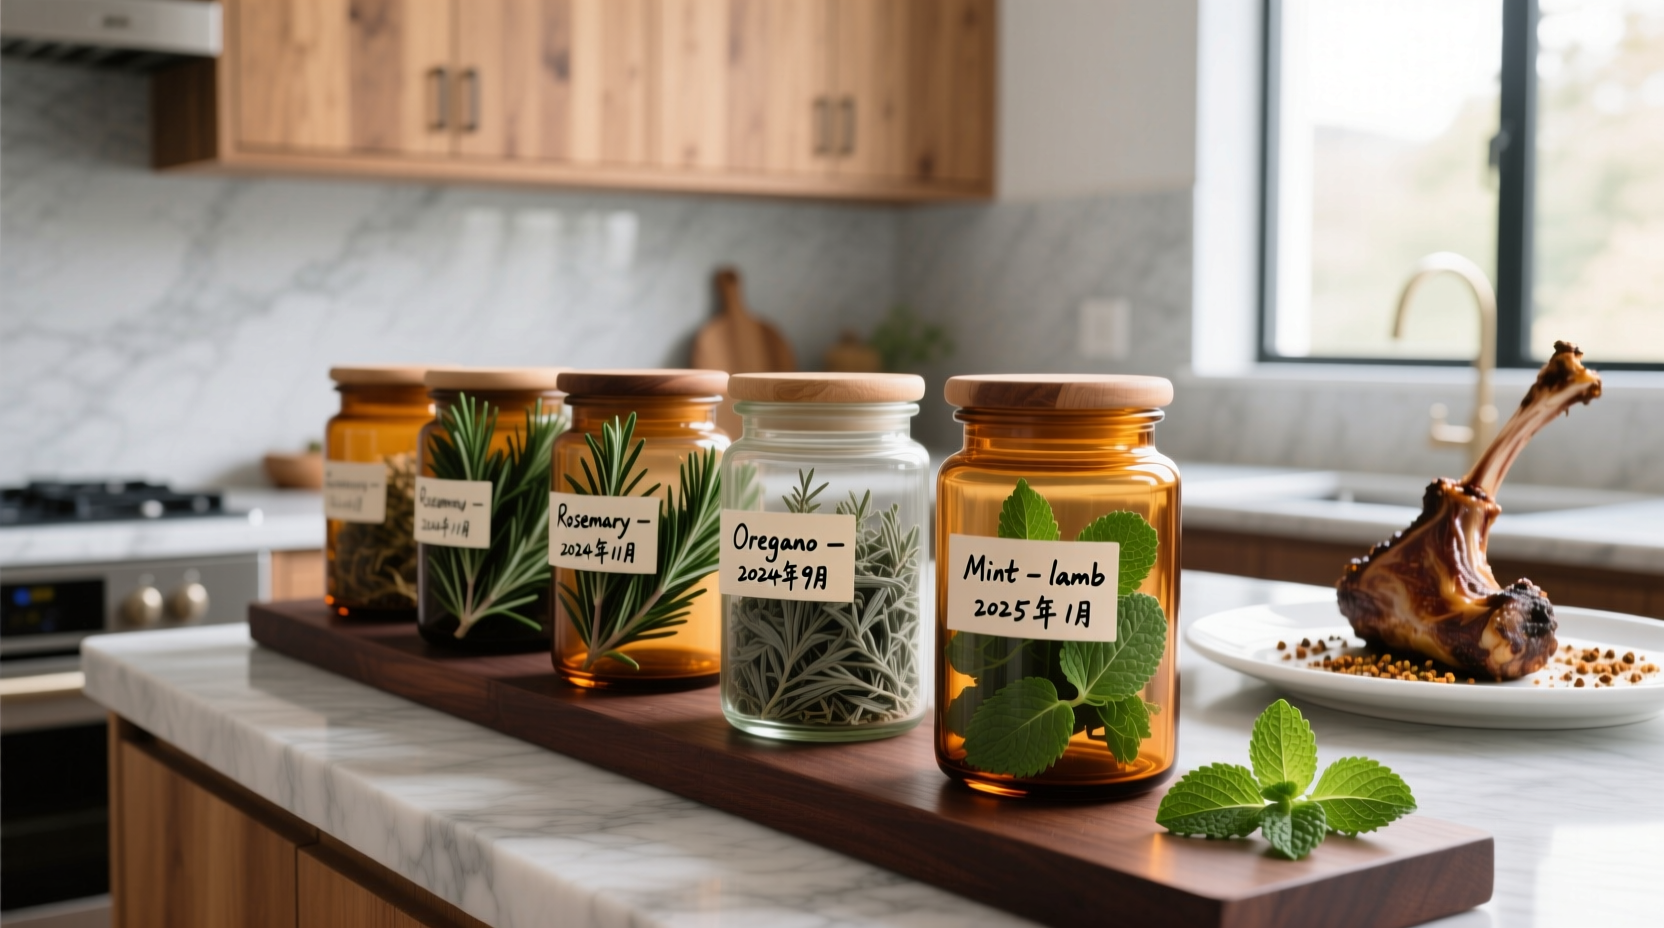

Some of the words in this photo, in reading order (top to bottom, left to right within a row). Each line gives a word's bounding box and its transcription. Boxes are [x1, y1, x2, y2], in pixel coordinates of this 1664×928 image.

[557, 502, 630, 540] Rosemary
[560, 537, 636, 565] 2024年11月
[733, 522, 818, 563] Oregano
[737, 560, 828, 592] 2024年9月
[963, 553, 1020, 584] Mint
[1049, 558, 1106, 587] lamb
